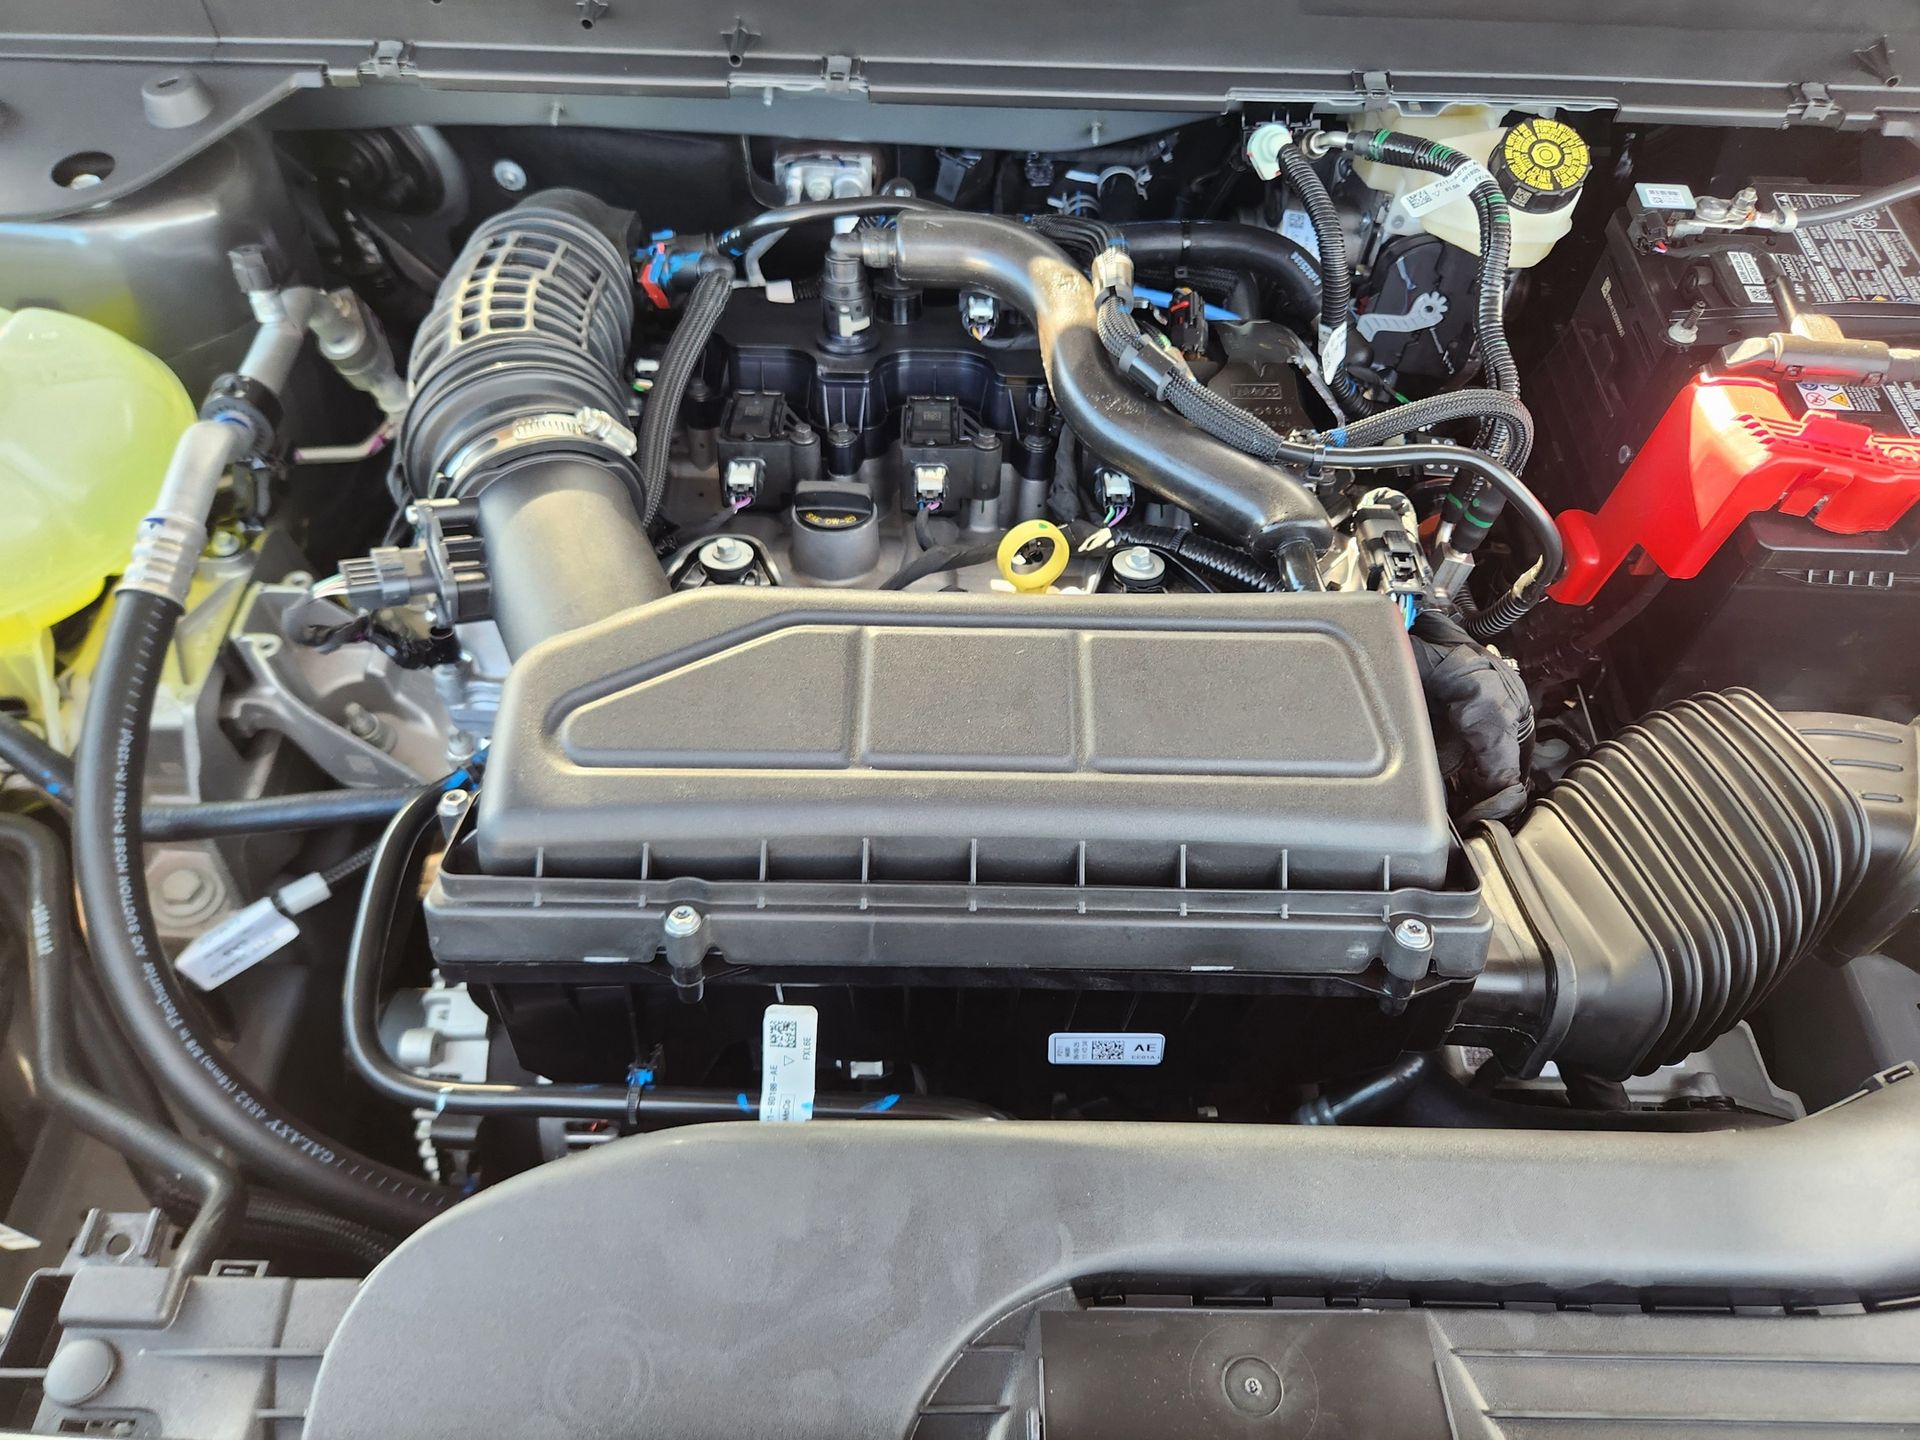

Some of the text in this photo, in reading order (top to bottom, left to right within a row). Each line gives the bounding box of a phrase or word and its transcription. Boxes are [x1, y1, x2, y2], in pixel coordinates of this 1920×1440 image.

[114, 837, 129, 874] HOSE
[119, 875, 141, 934] SUCTION
[131, 935, 149, 957] A/C
[143, 962, 184, 1029] Flexbarrier
[1133, 1043, 1158, 1053] AE
[235, 1090, 267, 1119] 4882
[265, 1119, 335, 1164] GALAXY
